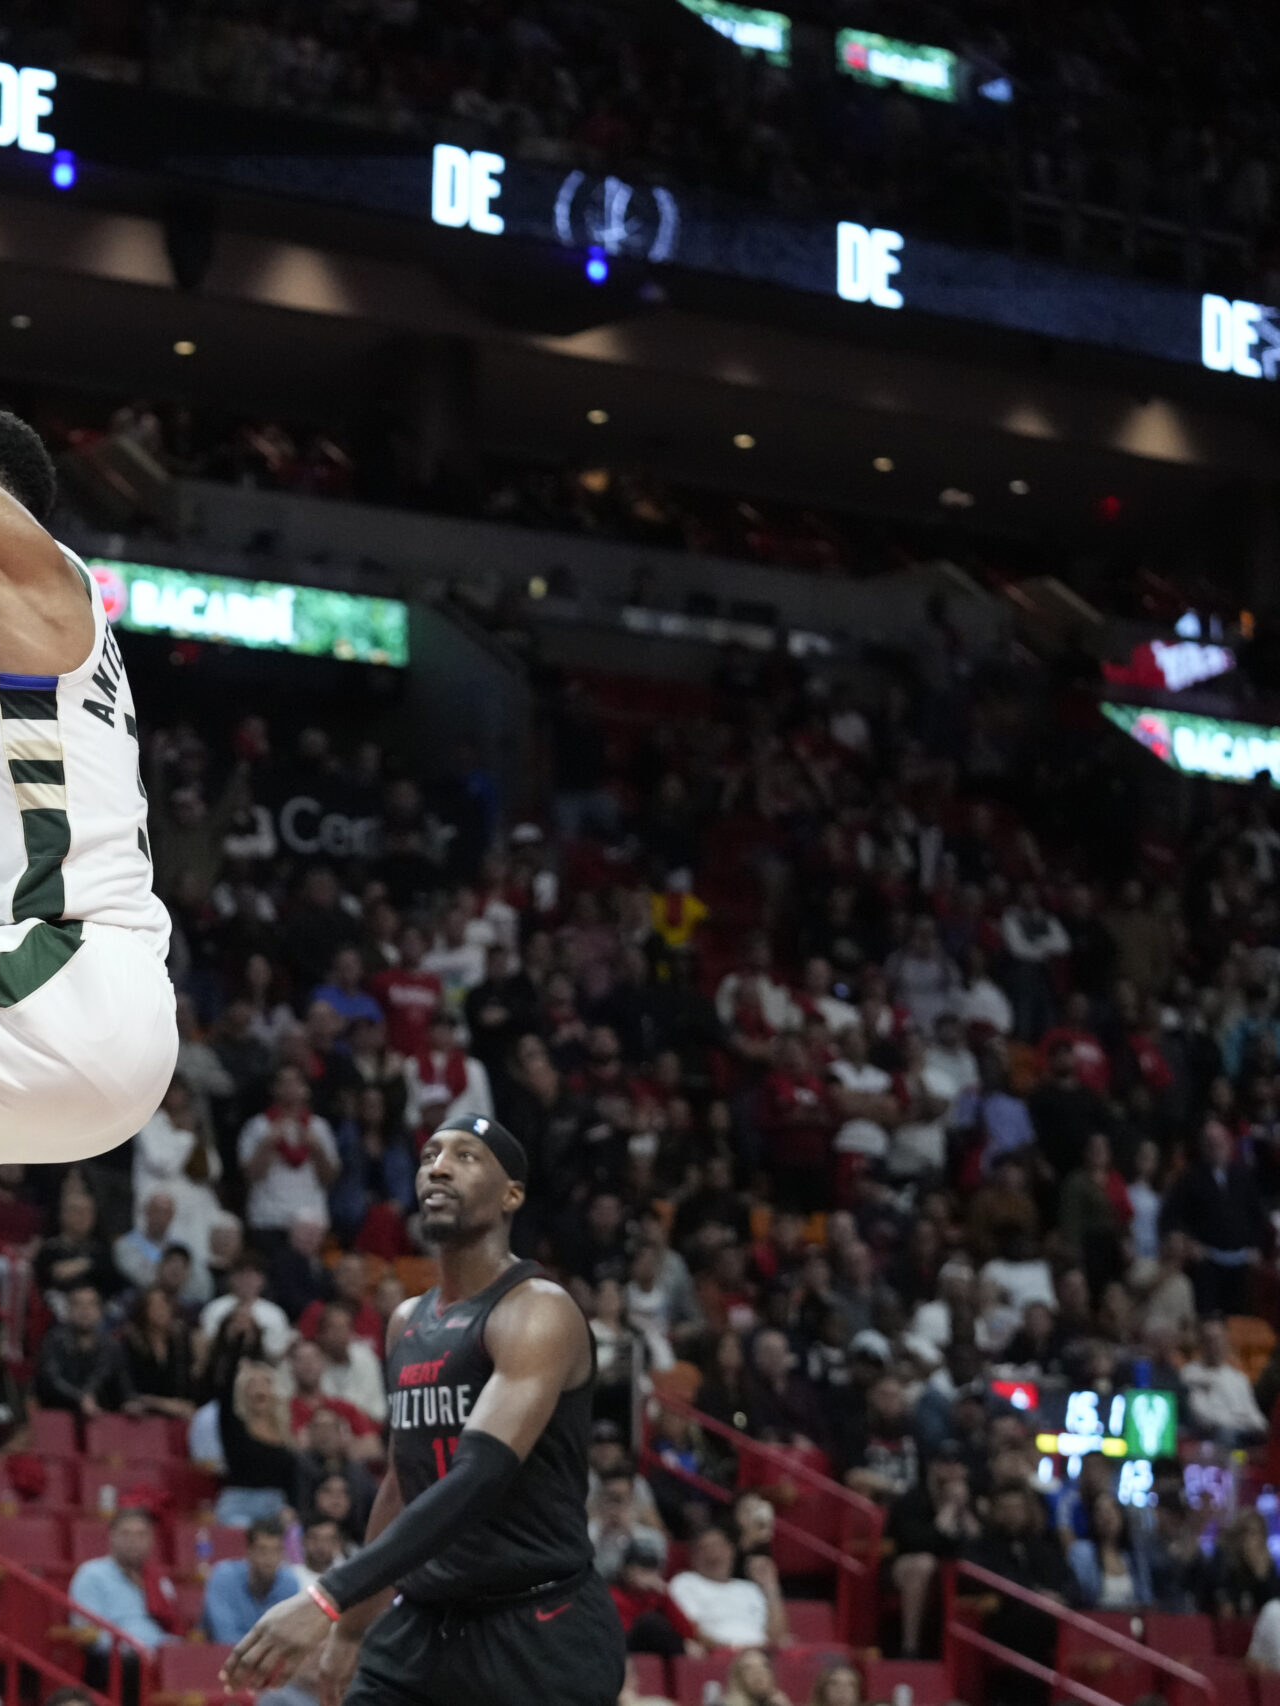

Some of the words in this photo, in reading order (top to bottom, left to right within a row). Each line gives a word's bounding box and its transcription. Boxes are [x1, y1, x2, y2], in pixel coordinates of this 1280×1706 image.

[432, 144, 506, 235] DE
[837, 221, 904, 309] DE
[1202, 293, 1262, 378] DE
[388, 1384, 472, 1430] ULTURE
[398, 1352, 451, 1387] HEAT
